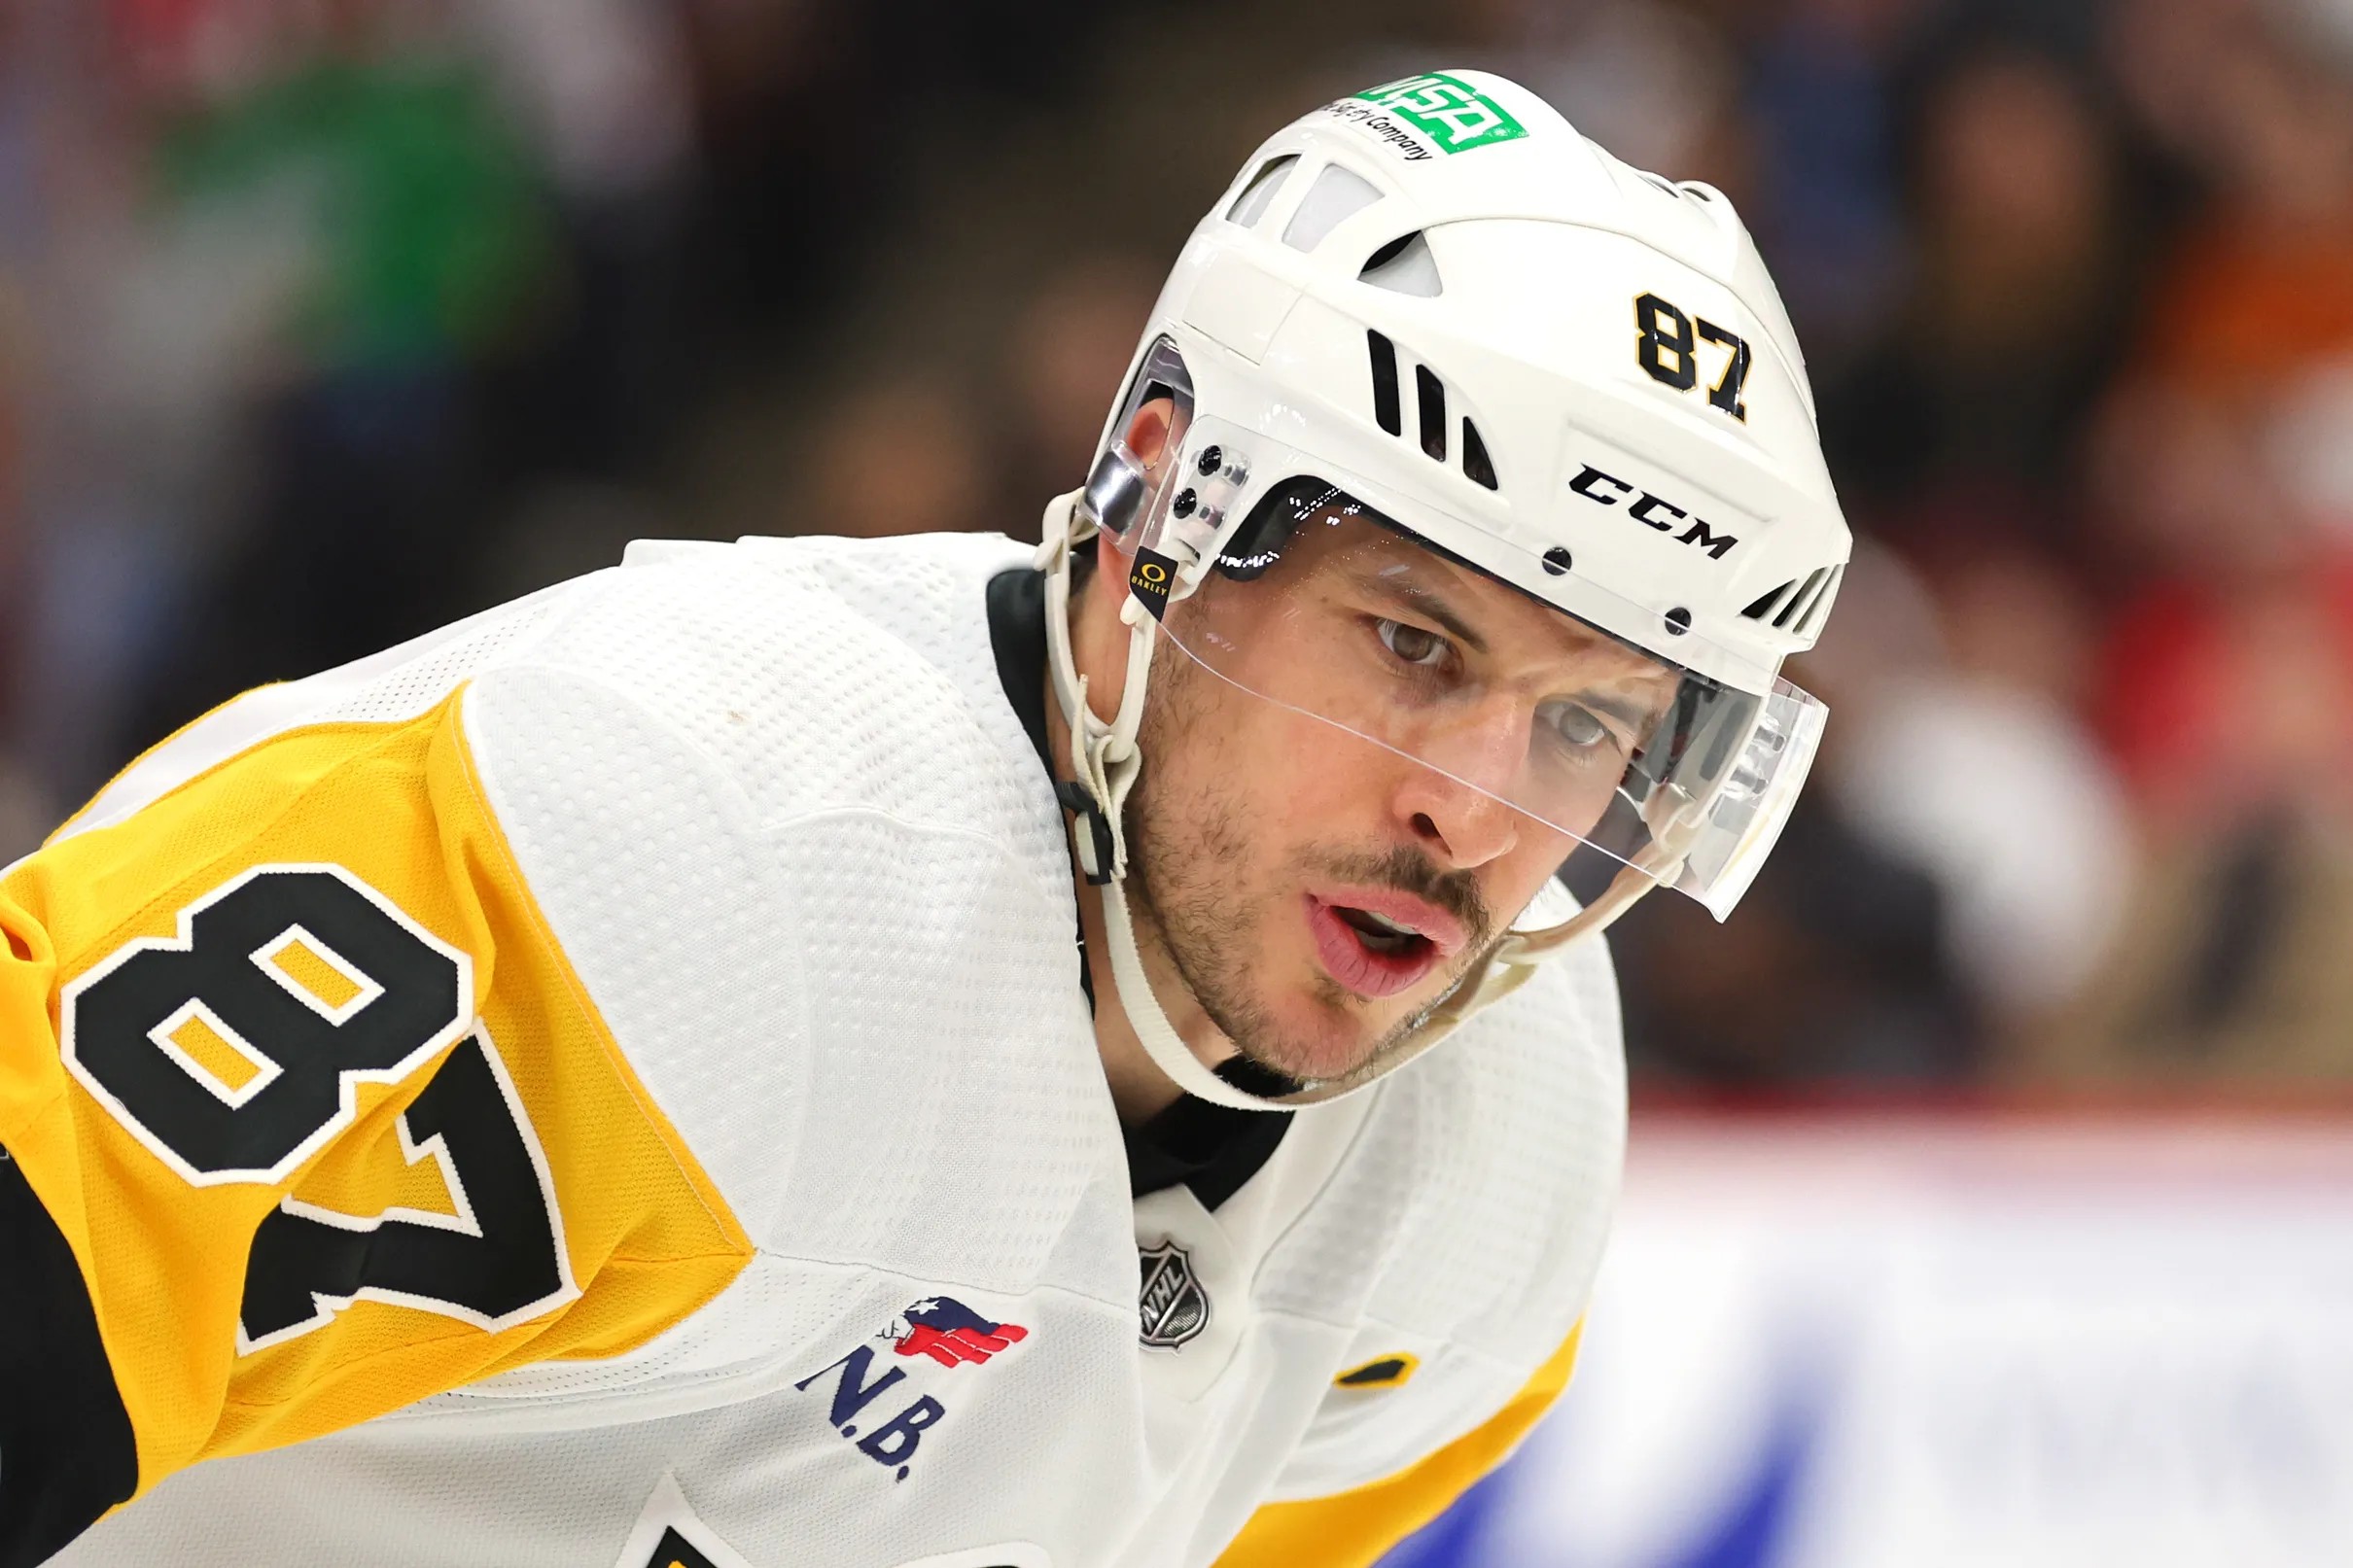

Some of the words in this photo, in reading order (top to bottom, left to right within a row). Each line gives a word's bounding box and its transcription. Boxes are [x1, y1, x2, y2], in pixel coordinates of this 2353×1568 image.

[1365, 116, 1433, 160] Company
[1632, 291, 1752, 426] 87
[1568, 462, 1738, 561] CCM
[1131, 575, 1167, 596] OAKLEY
[60, 862, 582, 1357] 87
[1141, 1265, 1184, 1334] NHL
[793, 1344, 945, 1484] N.B.
